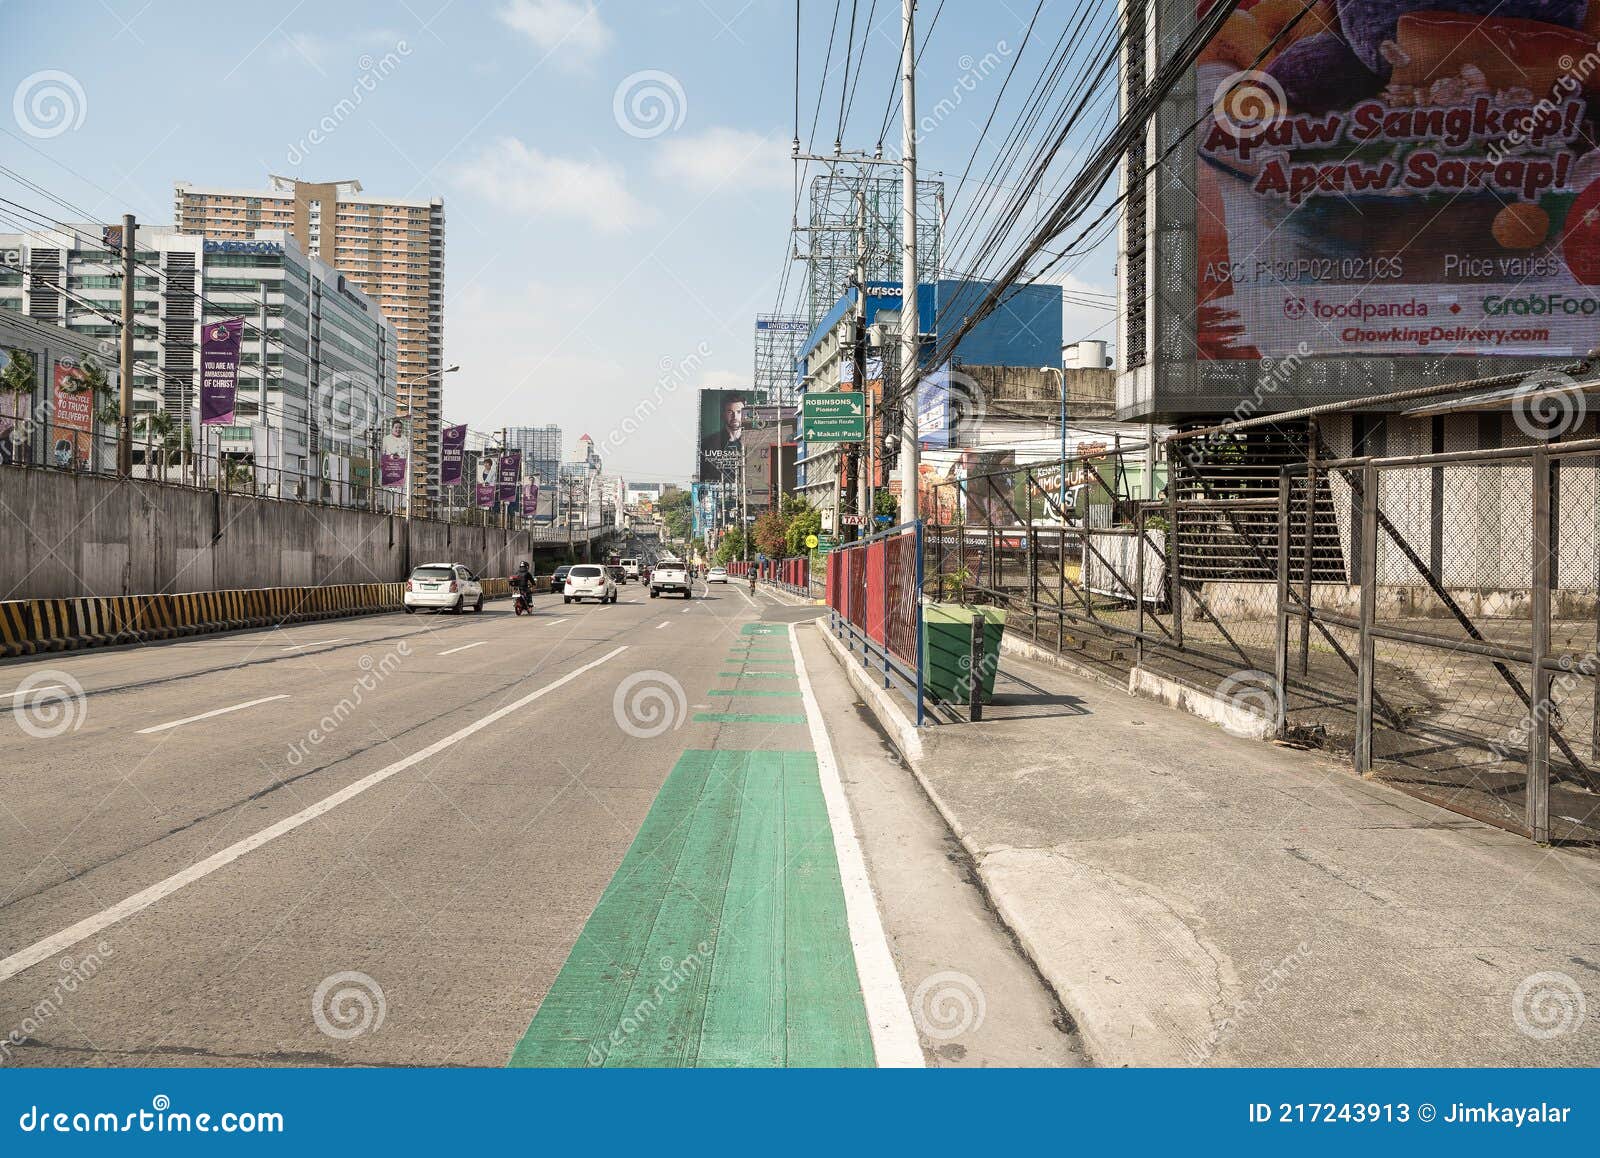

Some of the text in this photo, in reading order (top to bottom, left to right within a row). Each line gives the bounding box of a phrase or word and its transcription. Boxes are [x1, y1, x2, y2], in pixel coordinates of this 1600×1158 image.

[1203, 97, 1581, 161] Apaw Sangkap!
[1254, 152, 1571, 205] Apaw Sarap!
[1444, 253, 1493, 278] Price
[1499, 254, 1560, 278] varies
[1313, 294, 1600, 323] foodpanda GrabFoo
[1341, 327, 1550, 346] ChowkingDelivery.com
[204, 362, 215, 370] YOU
[216, 362, 226, 370] ARE
[204, 379, 212, 388] OF
[68, 401, 88, 412] TRUCK
[844, 515, 867, 525] TAXI
